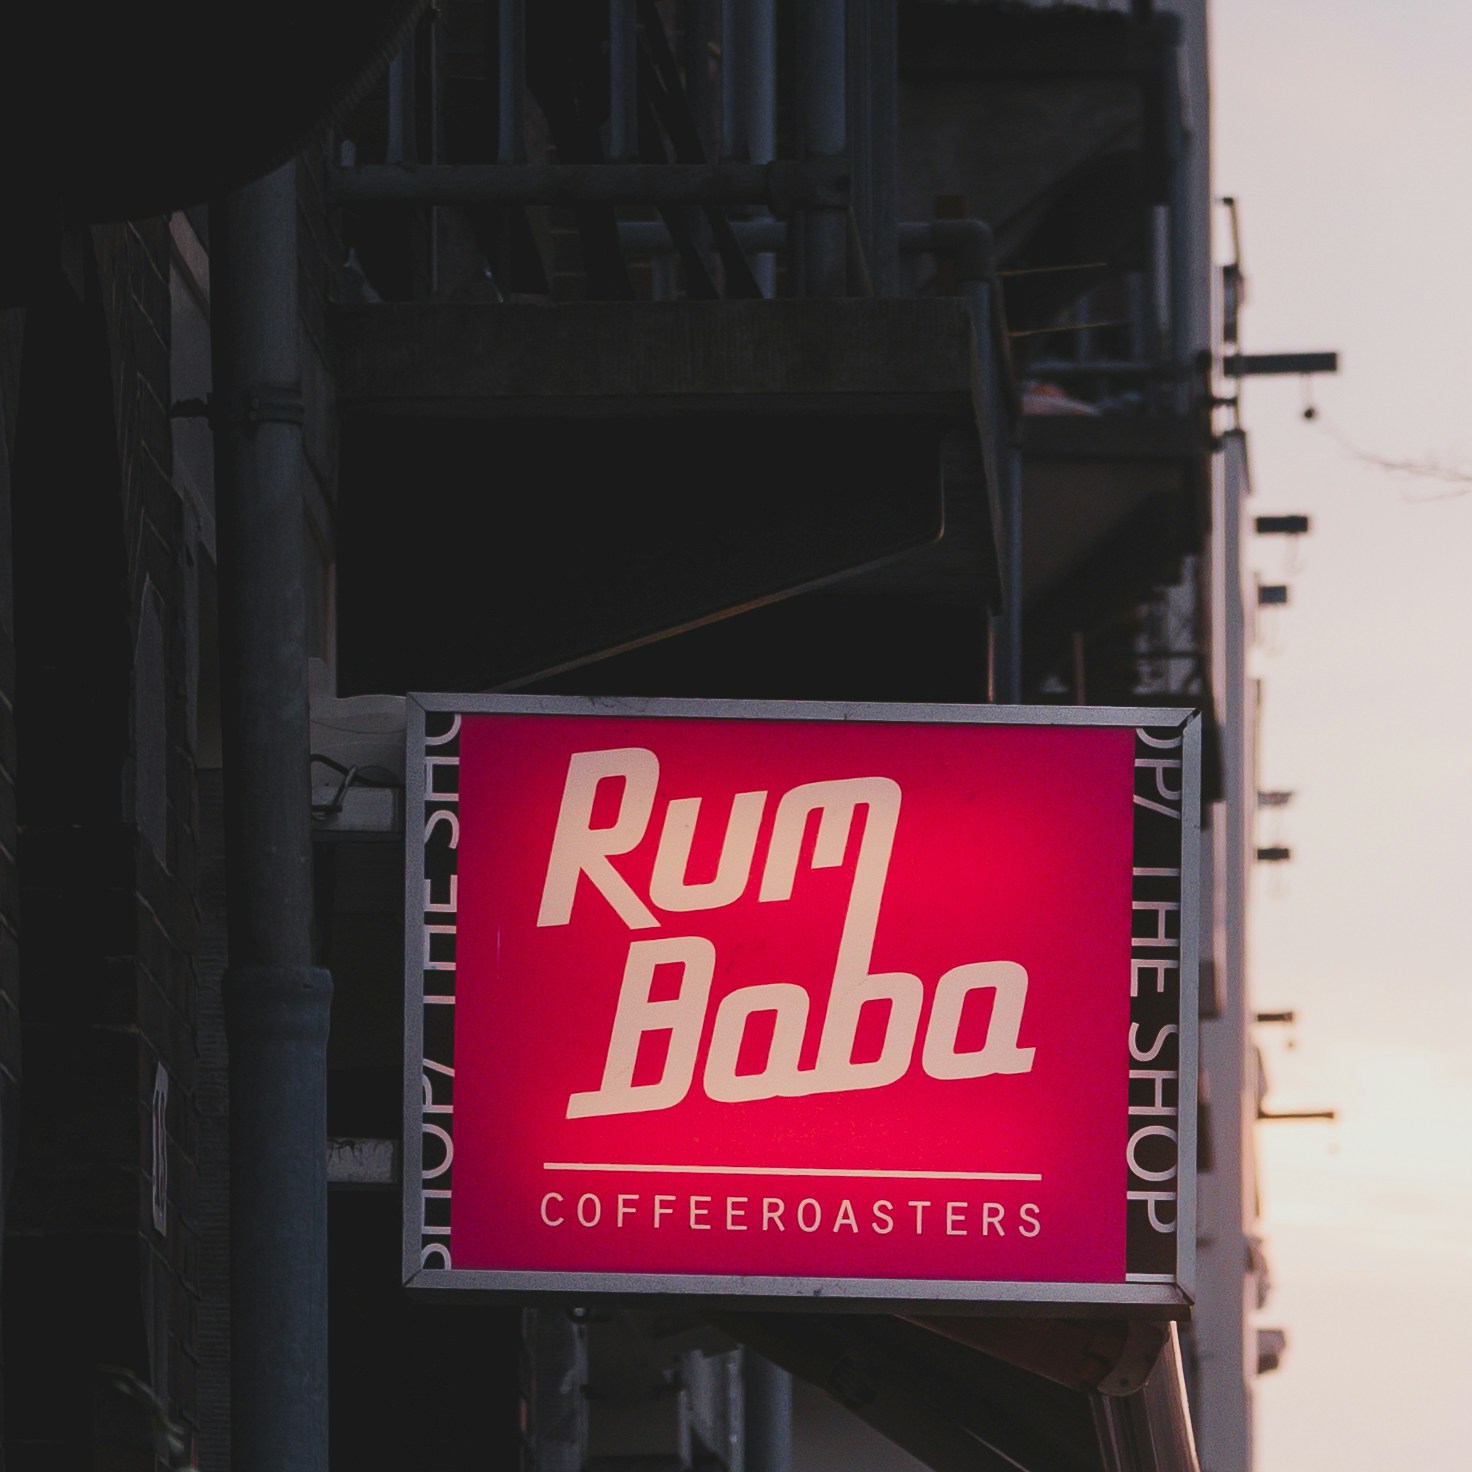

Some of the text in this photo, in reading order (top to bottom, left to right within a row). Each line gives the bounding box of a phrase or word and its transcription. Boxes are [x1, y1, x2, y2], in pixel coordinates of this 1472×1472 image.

[537, 748, 902, 929] Rum
[567, 937, 1036, 1119] Baba
[541, 1192, 1042, 1238] COFFEEROASTERS
[1125, 1022, 1178, 1234] SHOP
